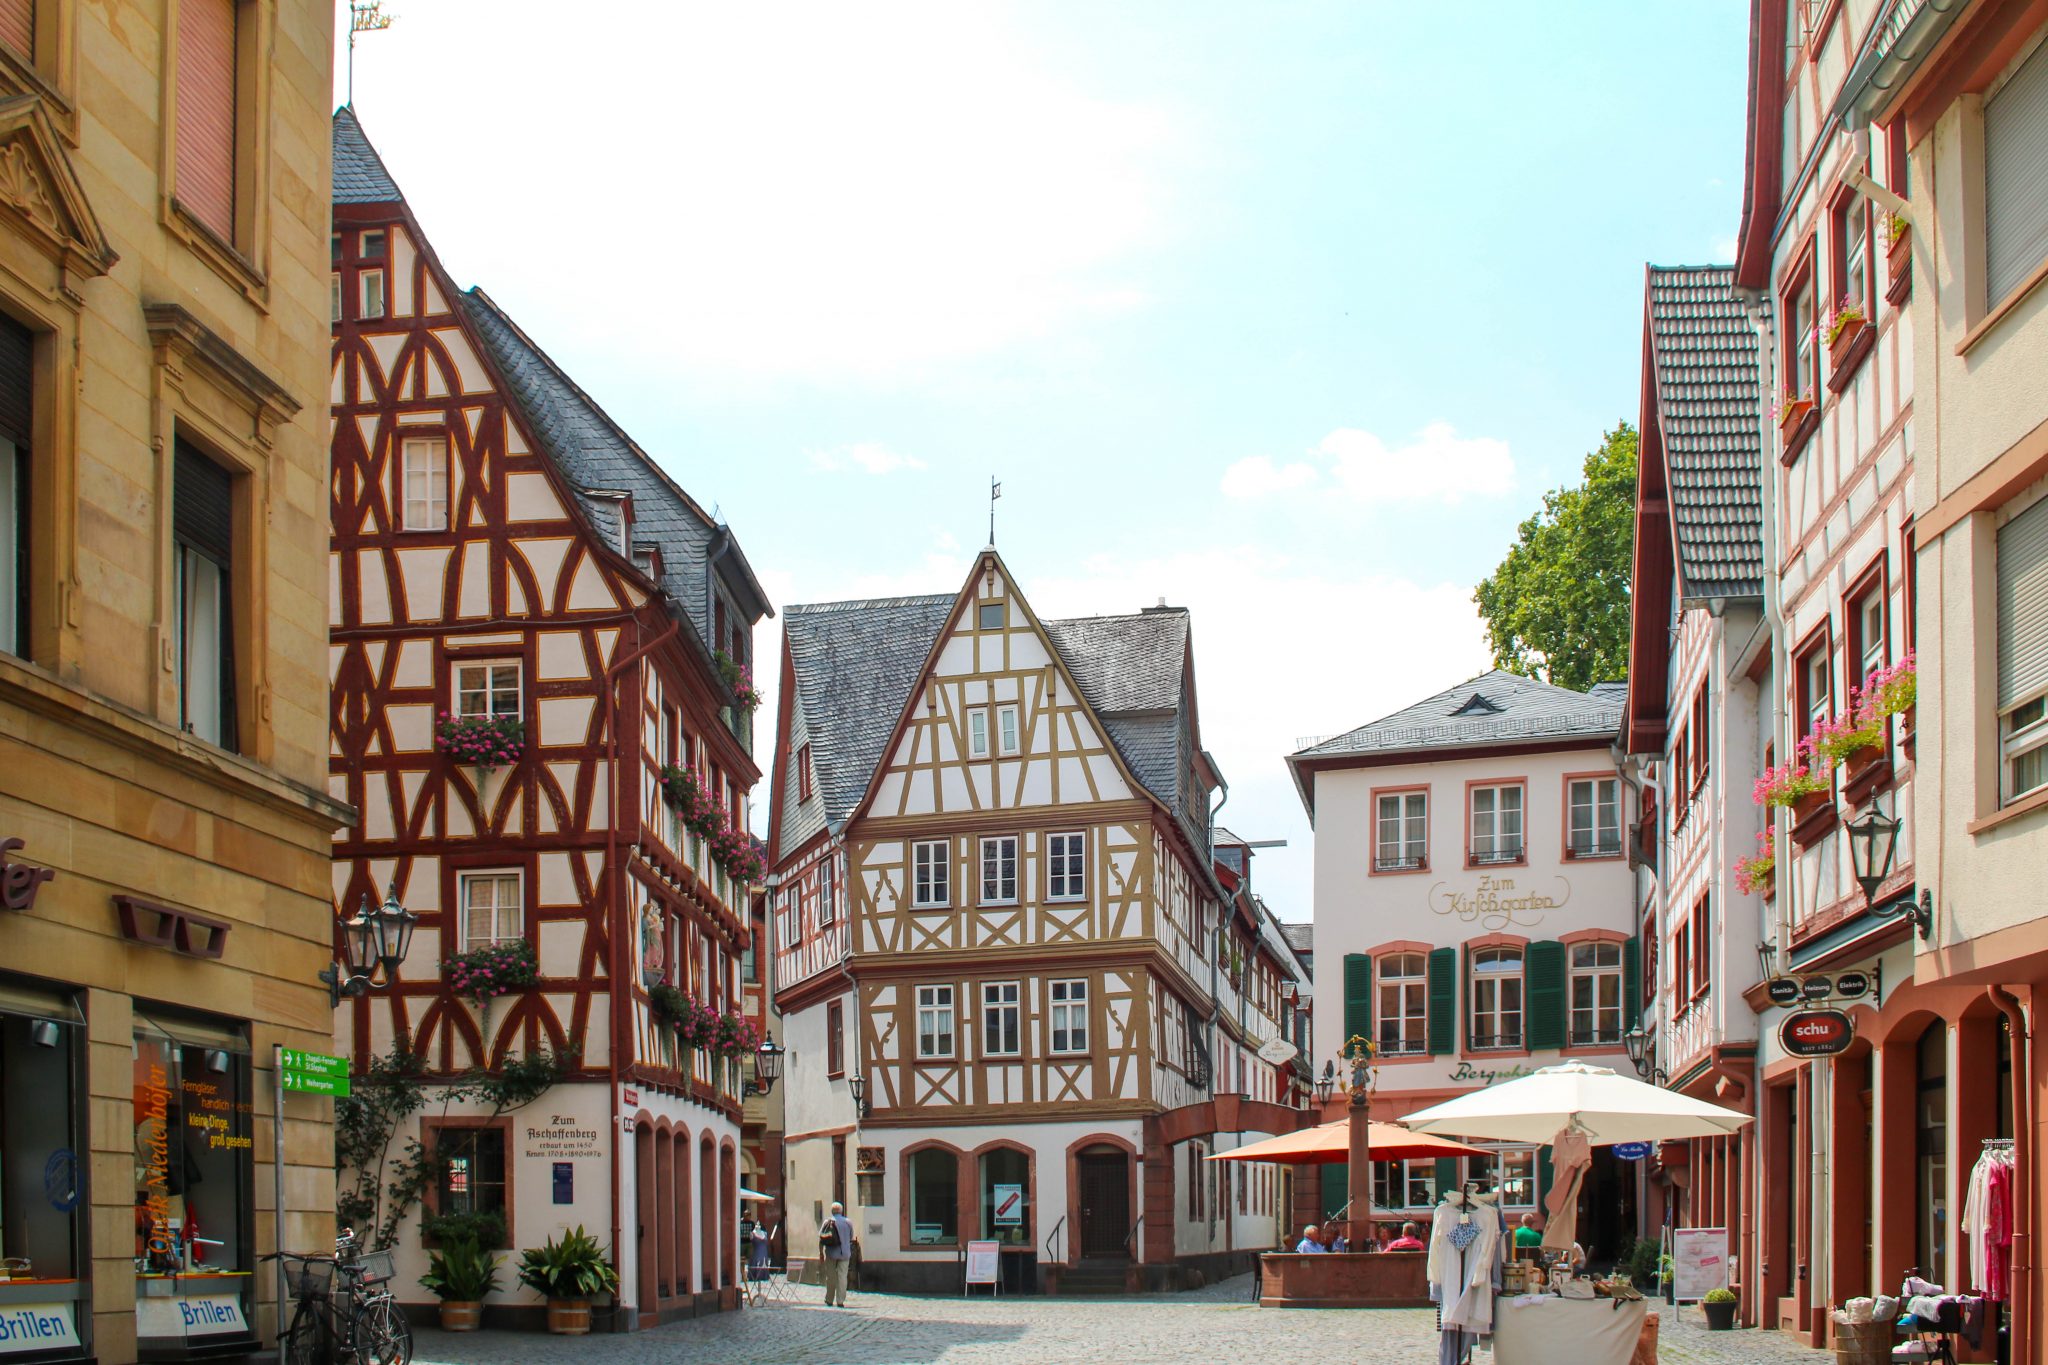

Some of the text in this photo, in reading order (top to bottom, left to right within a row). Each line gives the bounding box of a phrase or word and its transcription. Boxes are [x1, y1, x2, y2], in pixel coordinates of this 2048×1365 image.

[1477, 875, 1514, 892] Zum
[1437, 891, 1560, 925] Kirschgarten
[1772, 987, 1794, 995] Sanitär
[1805, 984, 1830, 992] Heizung
[1840, 981, 1864, 989] Elektrik
[144, 1064, 173, 1190] Niederhöfer
[189, 1112, 208, 1127] kleine
[551, 1115, 575, 1125] Zum
[527, 1128, 597, 1141] Aschaffenberg
[226, 1135, 252, 1150] gesehen
[178, 1302, 237, 1325] Brillen
[0, 1311, 66, 1340] Brillen
